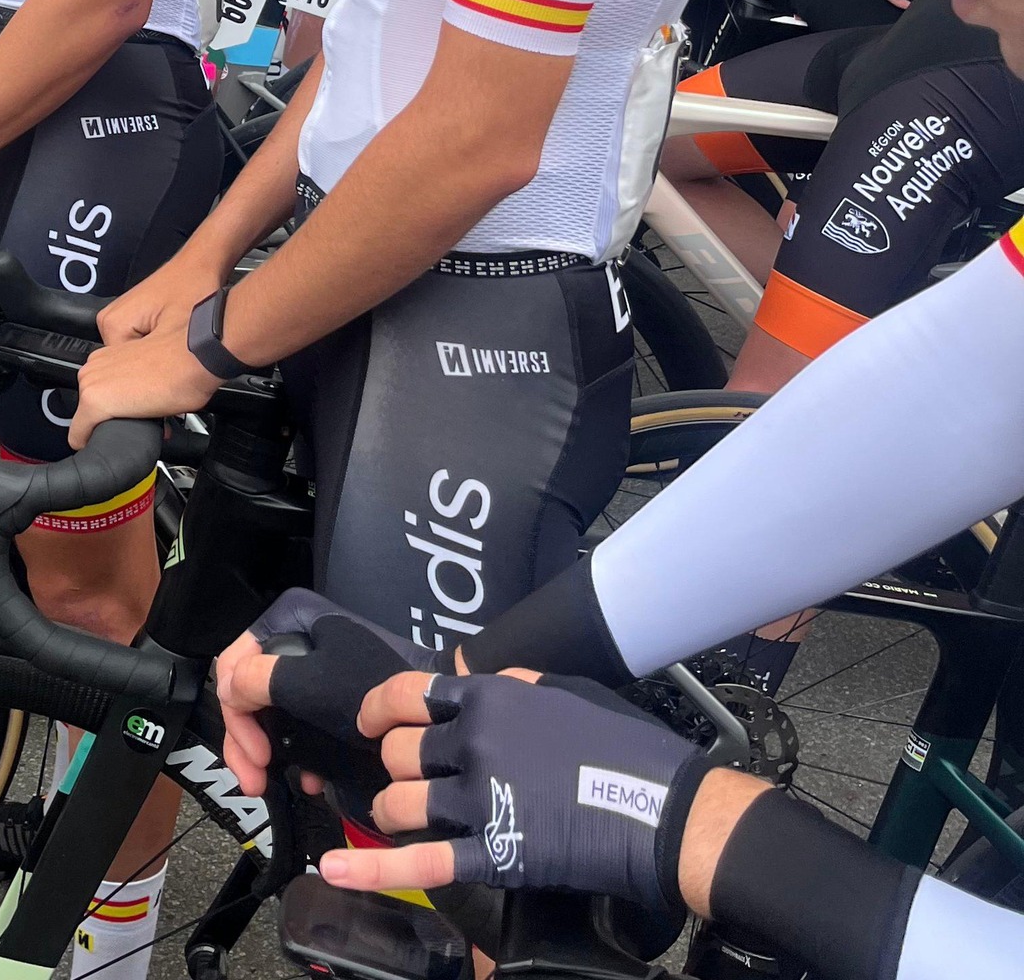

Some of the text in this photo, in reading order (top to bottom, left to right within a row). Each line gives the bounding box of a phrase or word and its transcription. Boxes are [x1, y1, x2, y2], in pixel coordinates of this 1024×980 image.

[105, 114, 159, 136] INVERSE
[868, 119, 905, 158] RÉGION
[852, 114, 951, 202] Nouvelle-
[472, 348, 551, 374] INVERSE
[127, 715, 165, 745] em
